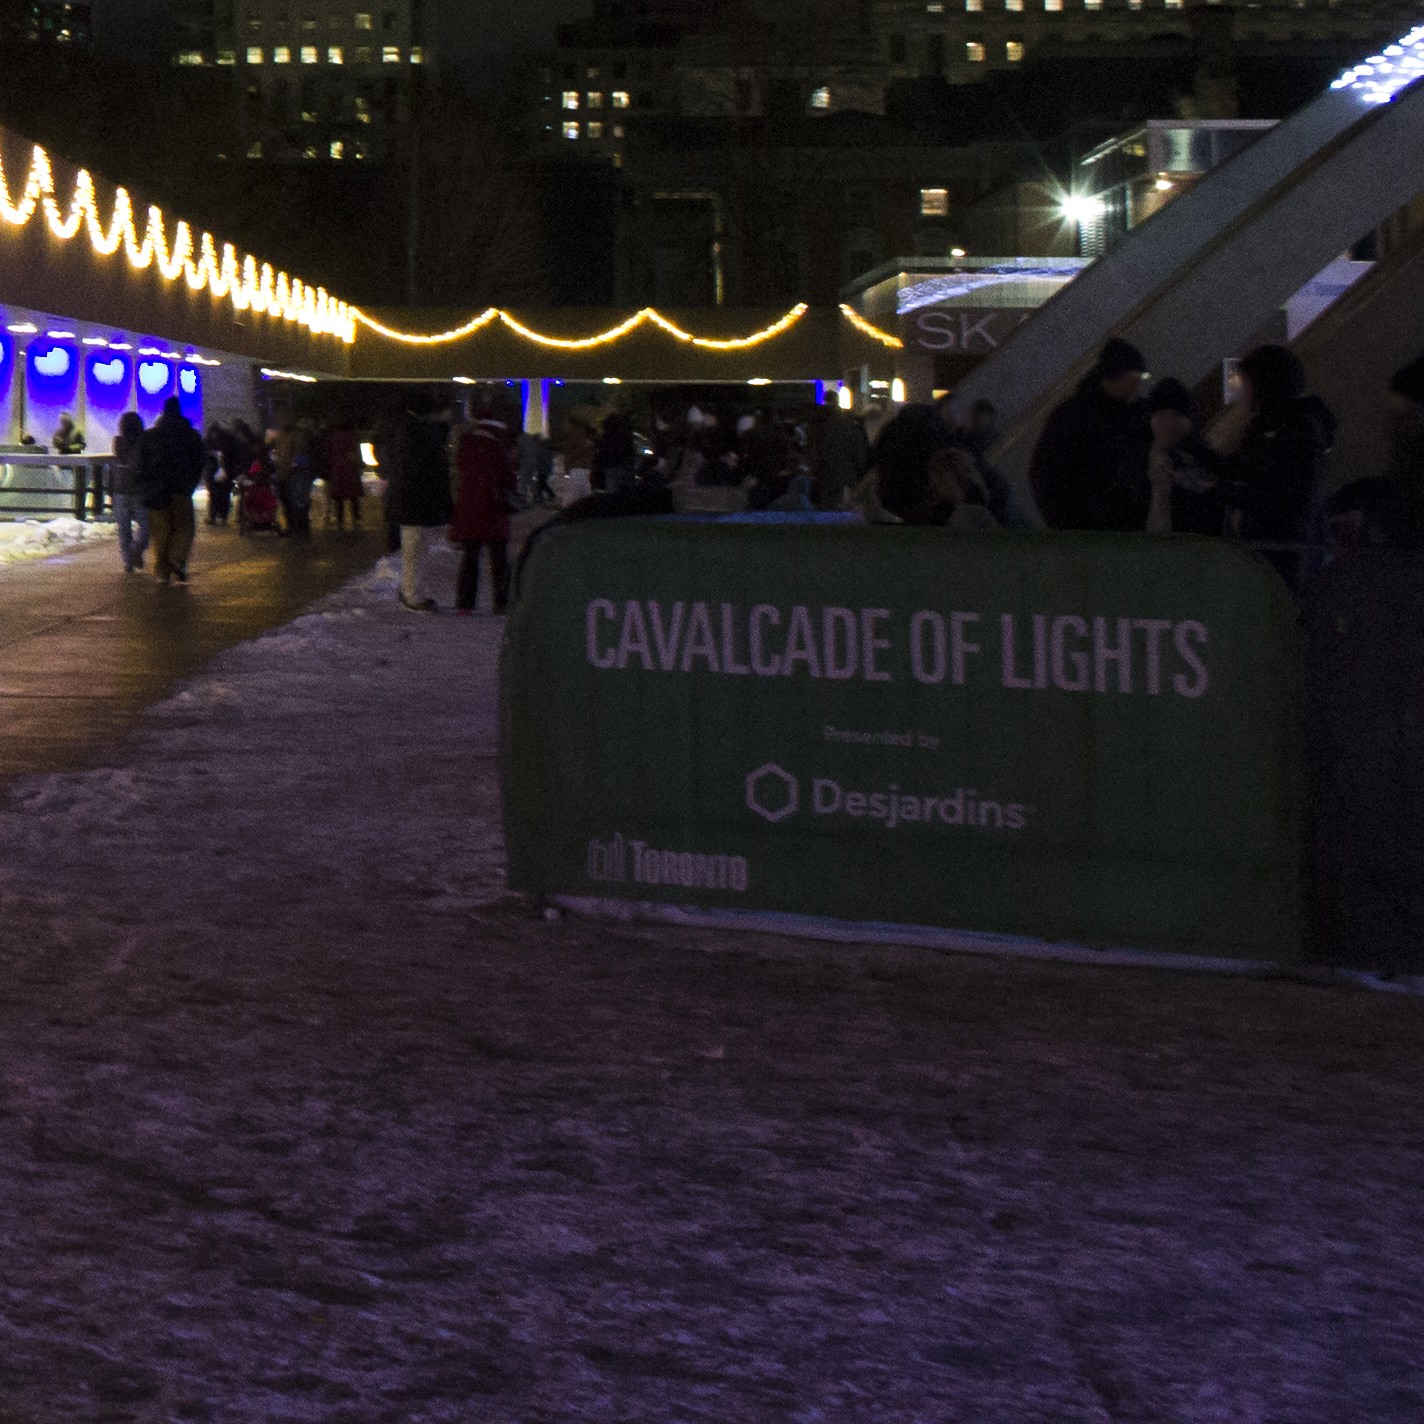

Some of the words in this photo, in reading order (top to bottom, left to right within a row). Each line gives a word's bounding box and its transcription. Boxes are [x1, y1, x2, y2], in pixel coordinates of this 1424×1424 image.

[916, 311, 1030, 350] SK
[585, 597, 892, 681] CAVALCADE
[909, 609, 981, 686] OF
[1001, 612, 1209, 699] LIGHTS
[812, 778, 1026, 829] Desjardins
